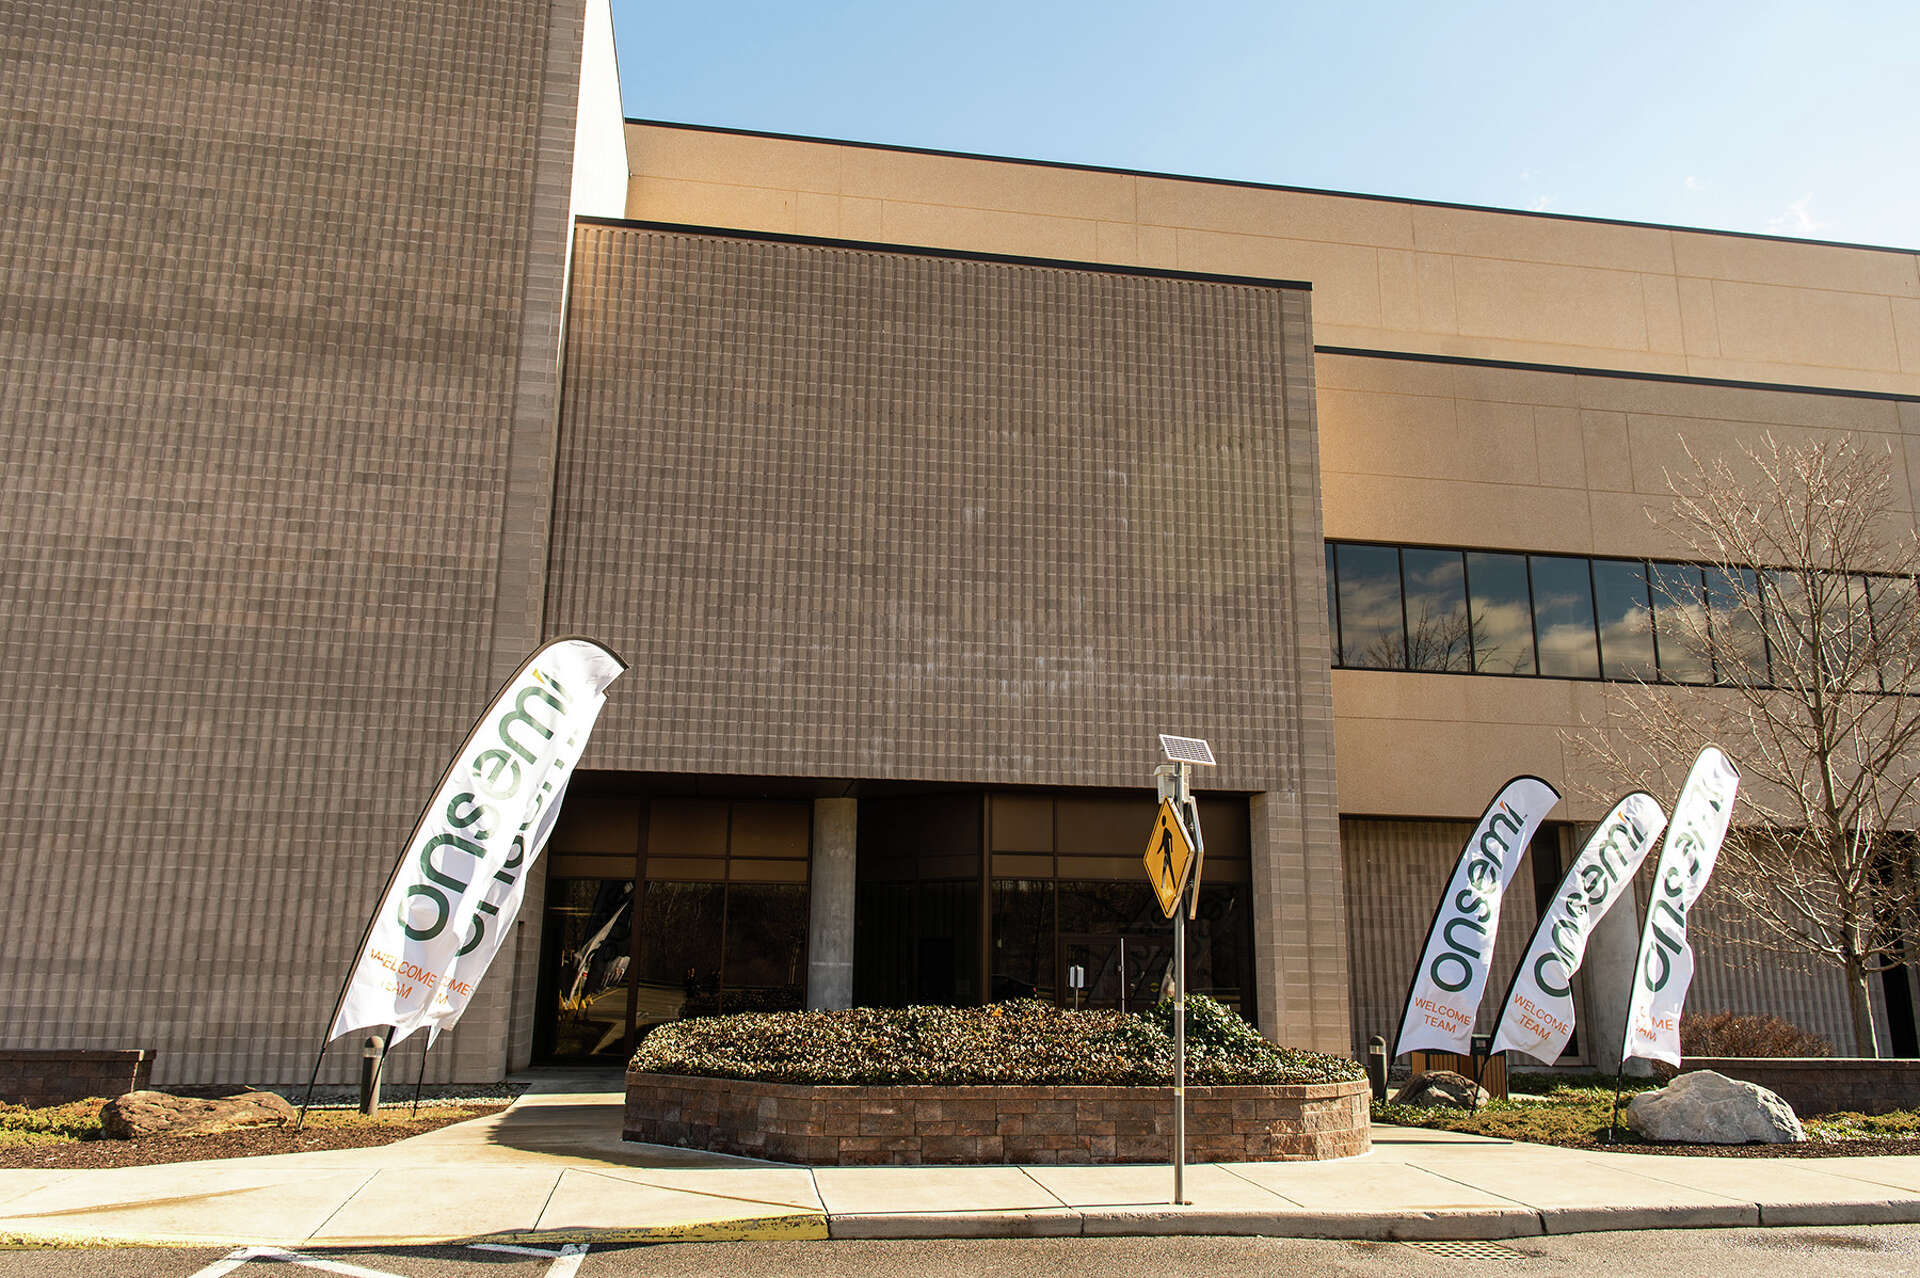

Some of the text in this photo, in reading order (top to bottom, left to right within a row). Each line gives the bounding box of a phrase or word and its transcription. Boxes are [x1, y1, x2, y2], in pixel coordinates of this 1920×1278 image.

[397, 668, 573, 942] onsemi
[1431, 800, 1525, 993] onsemi
[1534, 811, 1645, 998] onsemi
[370, 947, 438, 989] WELCOME
[1415, 996, 1472, 1026] WELCOME
[1424, 1013, 1457, 1033] TEAM
[1513, 993, 1569, 1036] WELCOME
[1518, 1013, 1551, 1041] TEAM
